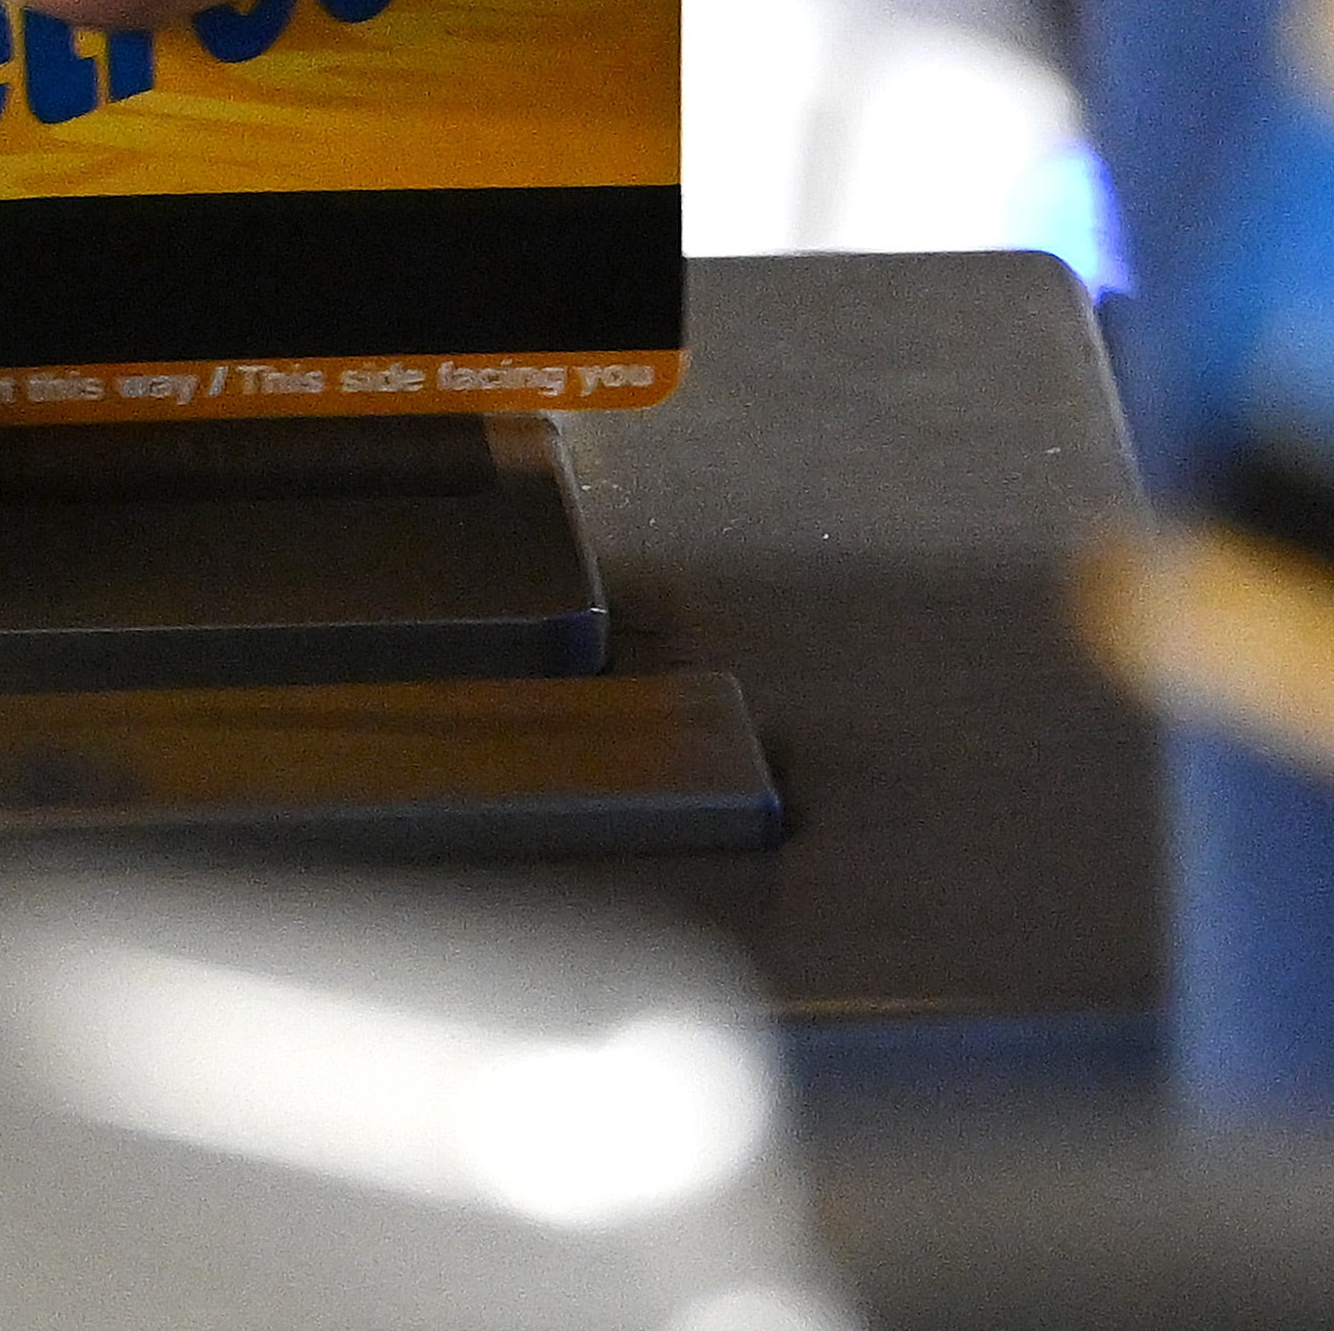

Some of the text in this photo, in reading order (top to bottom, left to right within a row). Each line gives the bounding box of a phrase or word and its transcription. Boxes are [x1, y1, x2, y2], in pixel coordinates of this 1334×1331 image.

[26, 371, 105, 402] this
[117, 374, 198, 407] way
[207, 365, 229, 398] /
[235, 362, 325, 395] This
[340, 362, 425, 393] side
[437, 359, 565, 396] facing
[572, 364, 655, 396] you
